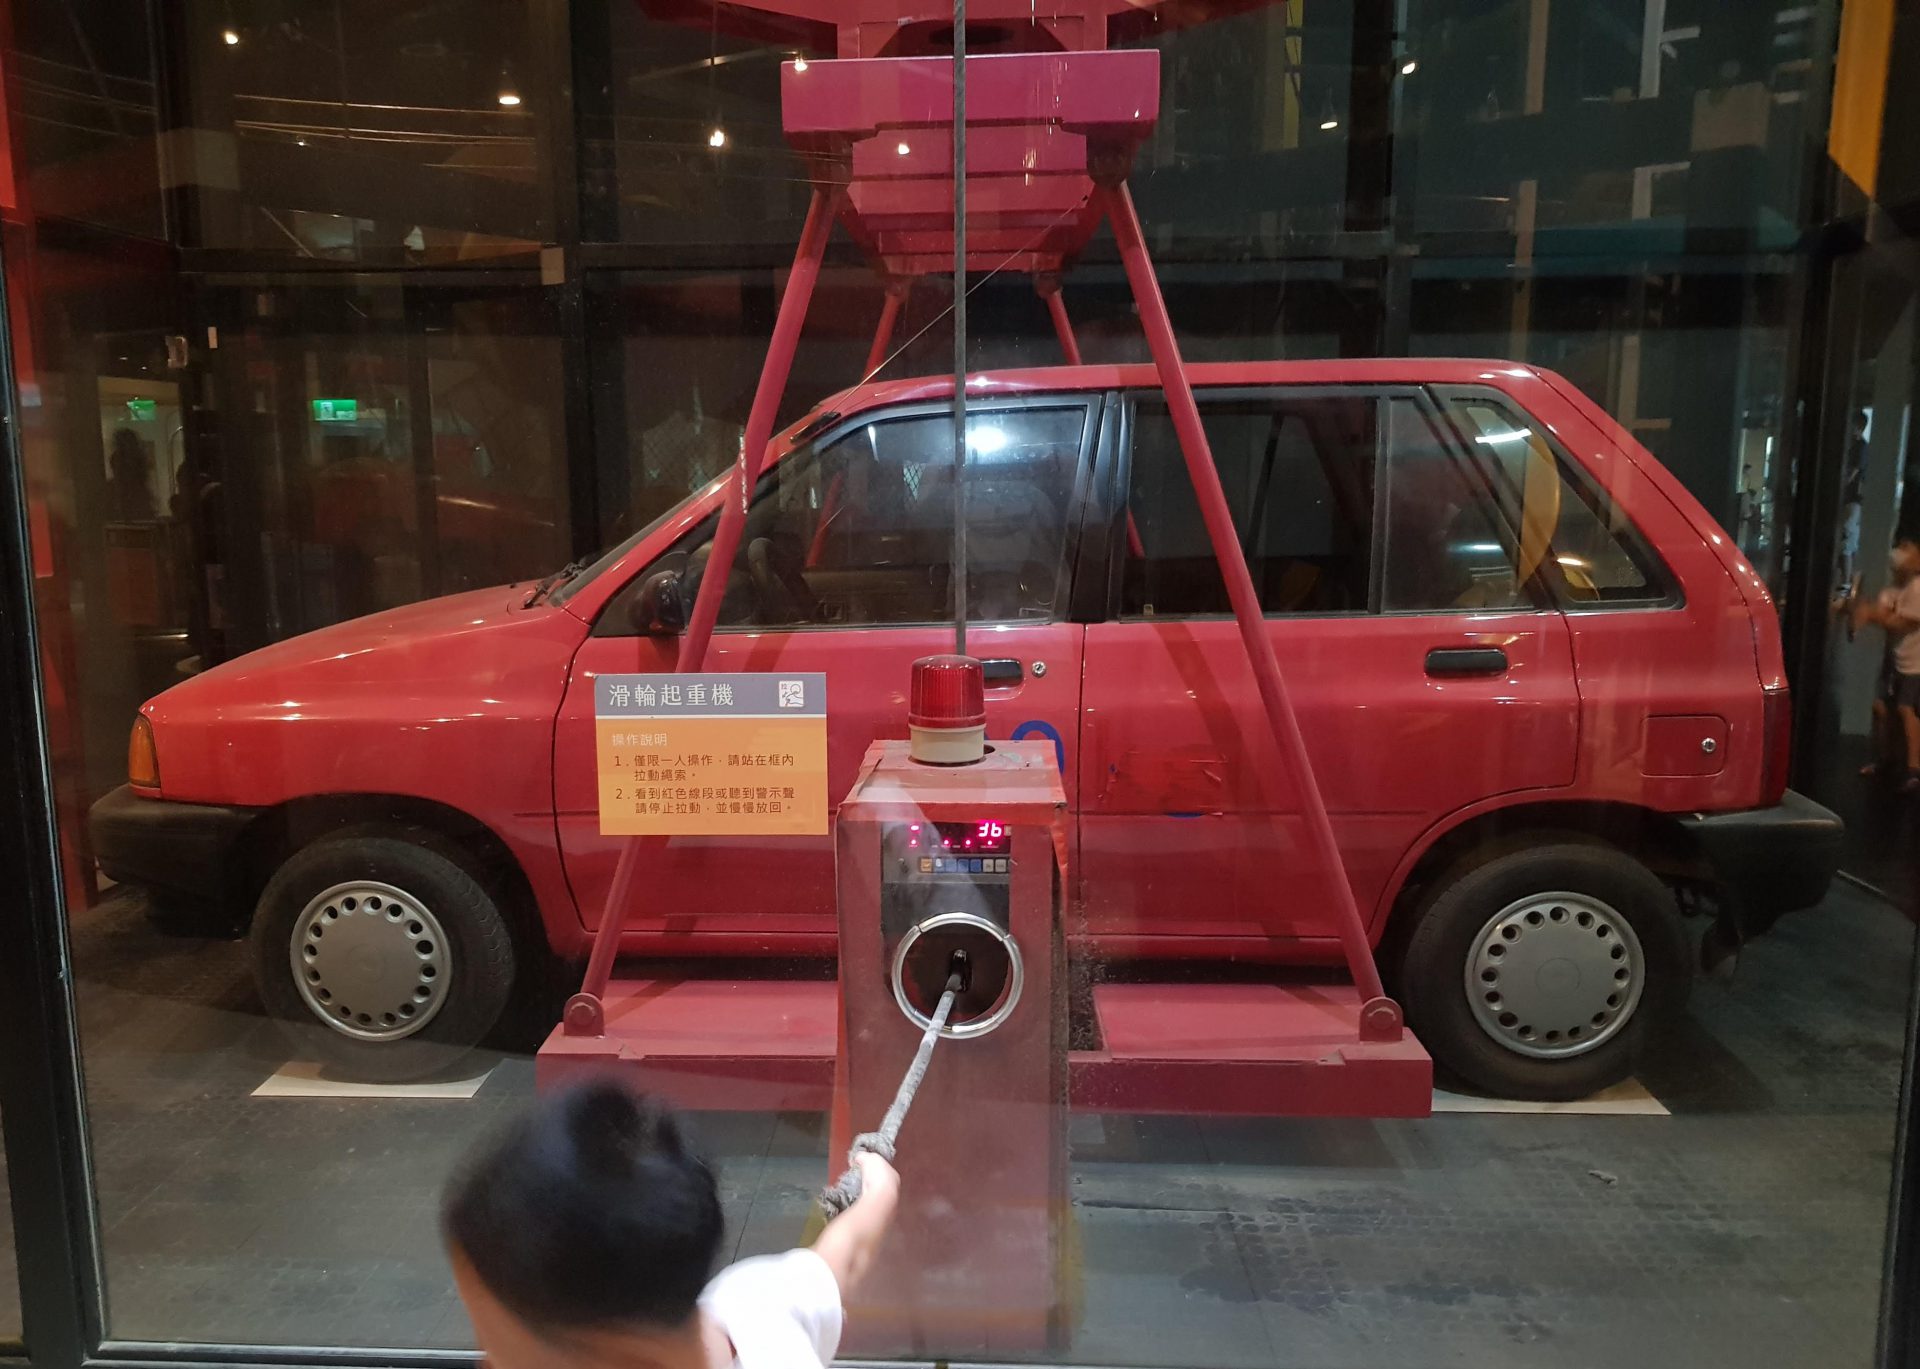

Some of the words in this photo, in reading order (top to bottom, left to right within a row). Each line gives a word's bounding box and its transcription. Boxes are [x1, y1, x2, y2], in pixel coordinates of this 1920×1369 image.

[609, 683, 734, 707] 滑輪起重機
[612, 733, 668, 747] 操作說明
[634, 786, 795, 800] 看到紅色線段或聽到警示聲
